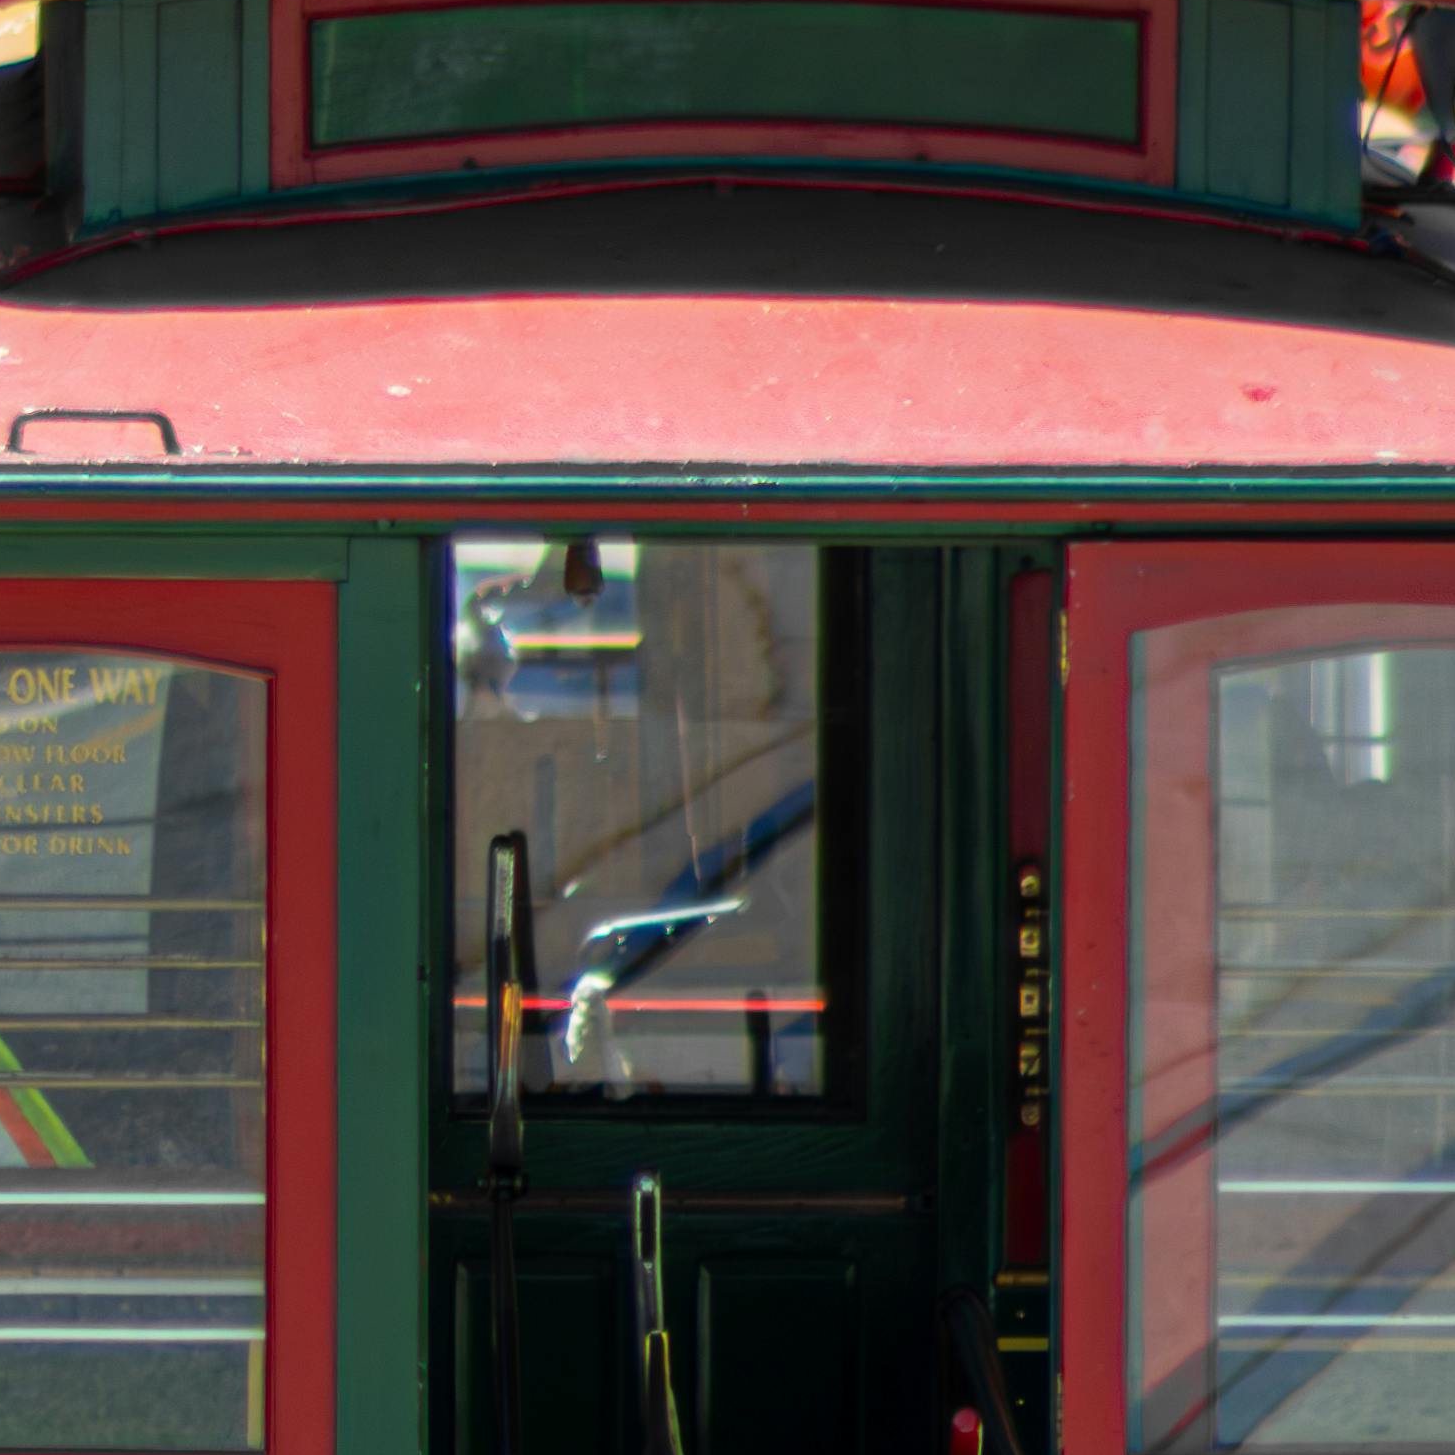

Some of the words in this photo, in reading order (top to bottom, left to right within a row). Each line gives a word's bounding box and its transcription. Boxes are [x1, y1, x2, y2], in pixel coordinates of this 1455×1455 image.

[7, 667, 75, 705] ONE
[89, 667, 162, 705] WAY
[18, 714, 58, 735] ON
[0, 834, 39, 856] OR
[48, 834, 133, 856] DRINK
